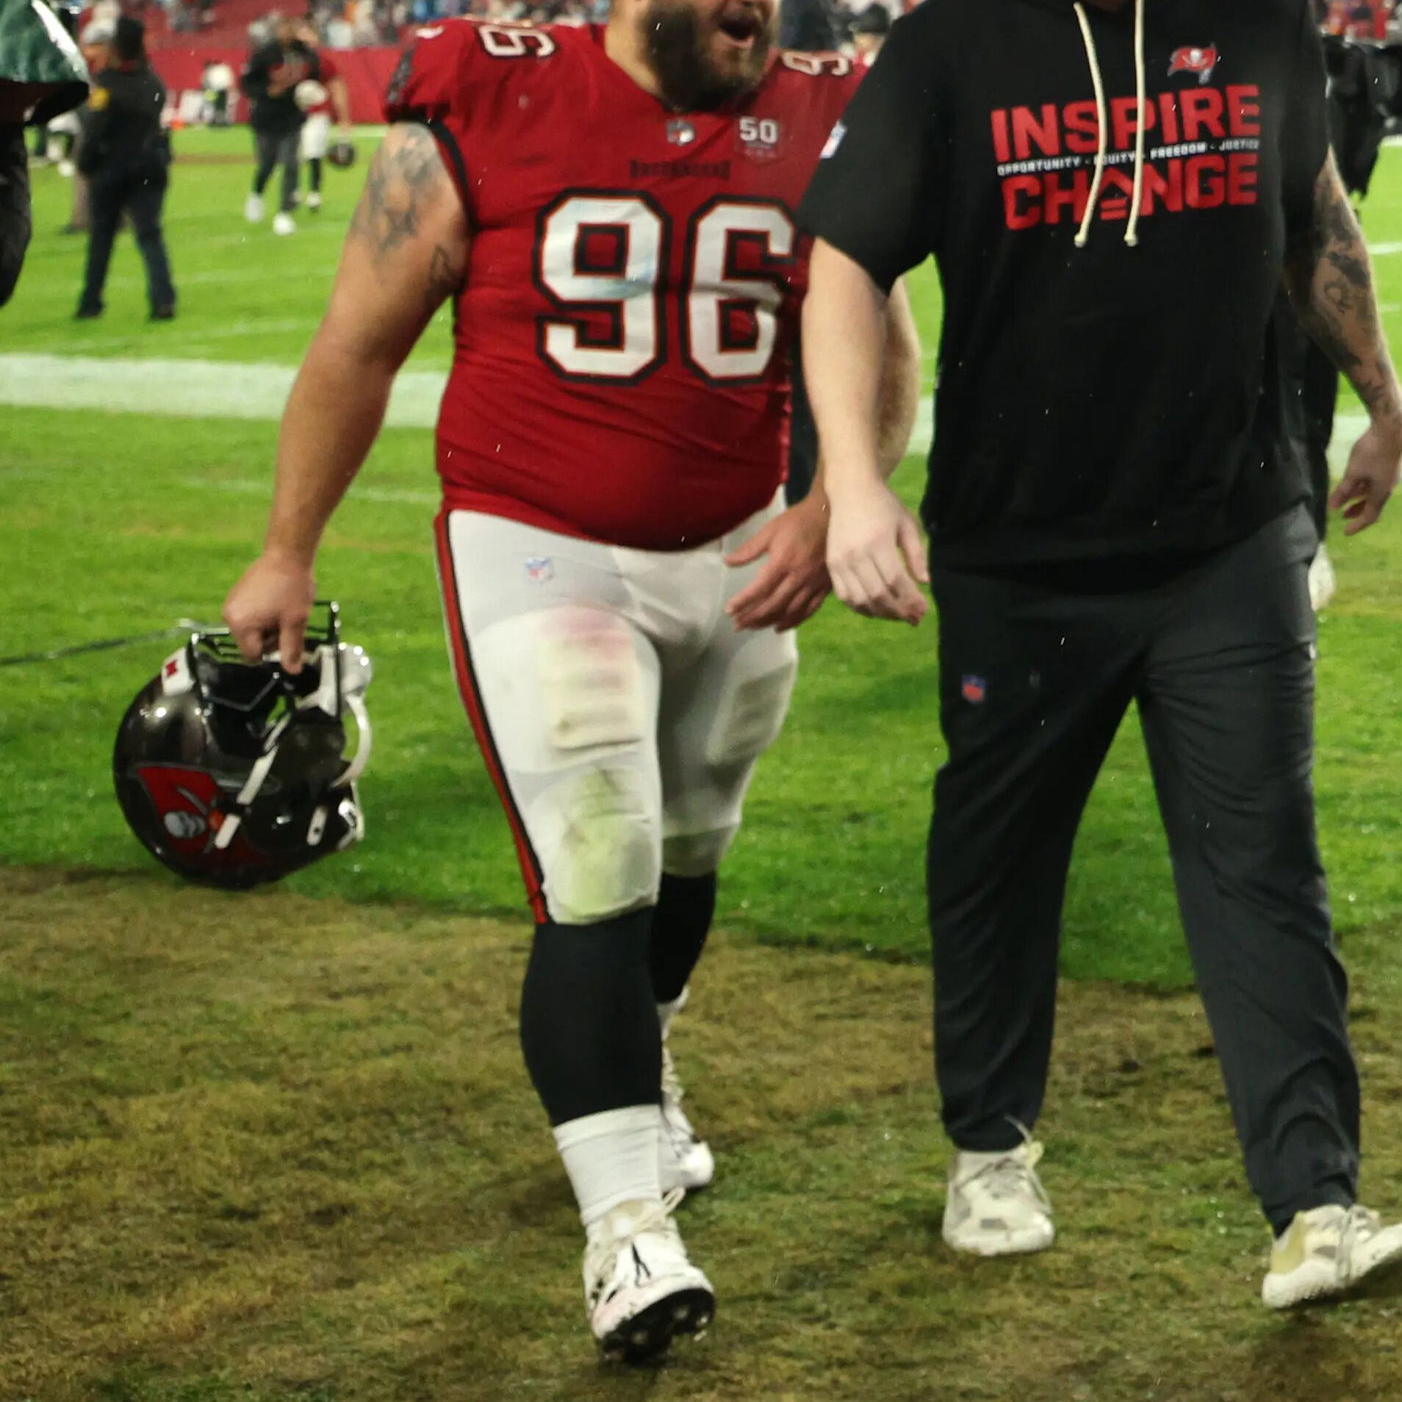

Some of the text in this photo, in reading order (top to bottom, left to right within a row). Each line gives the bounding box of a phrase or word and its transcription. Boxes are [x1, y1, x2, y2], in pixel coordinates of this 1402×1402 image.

[739, 116, 778, 144] 50
[989, 83, 1262, 163] INSPIRE
[1149, 142, 1208, 161] FREEDOM
[1001, 152, 1260, 231] CHANGE
[534, 190, 797, 385] 96
